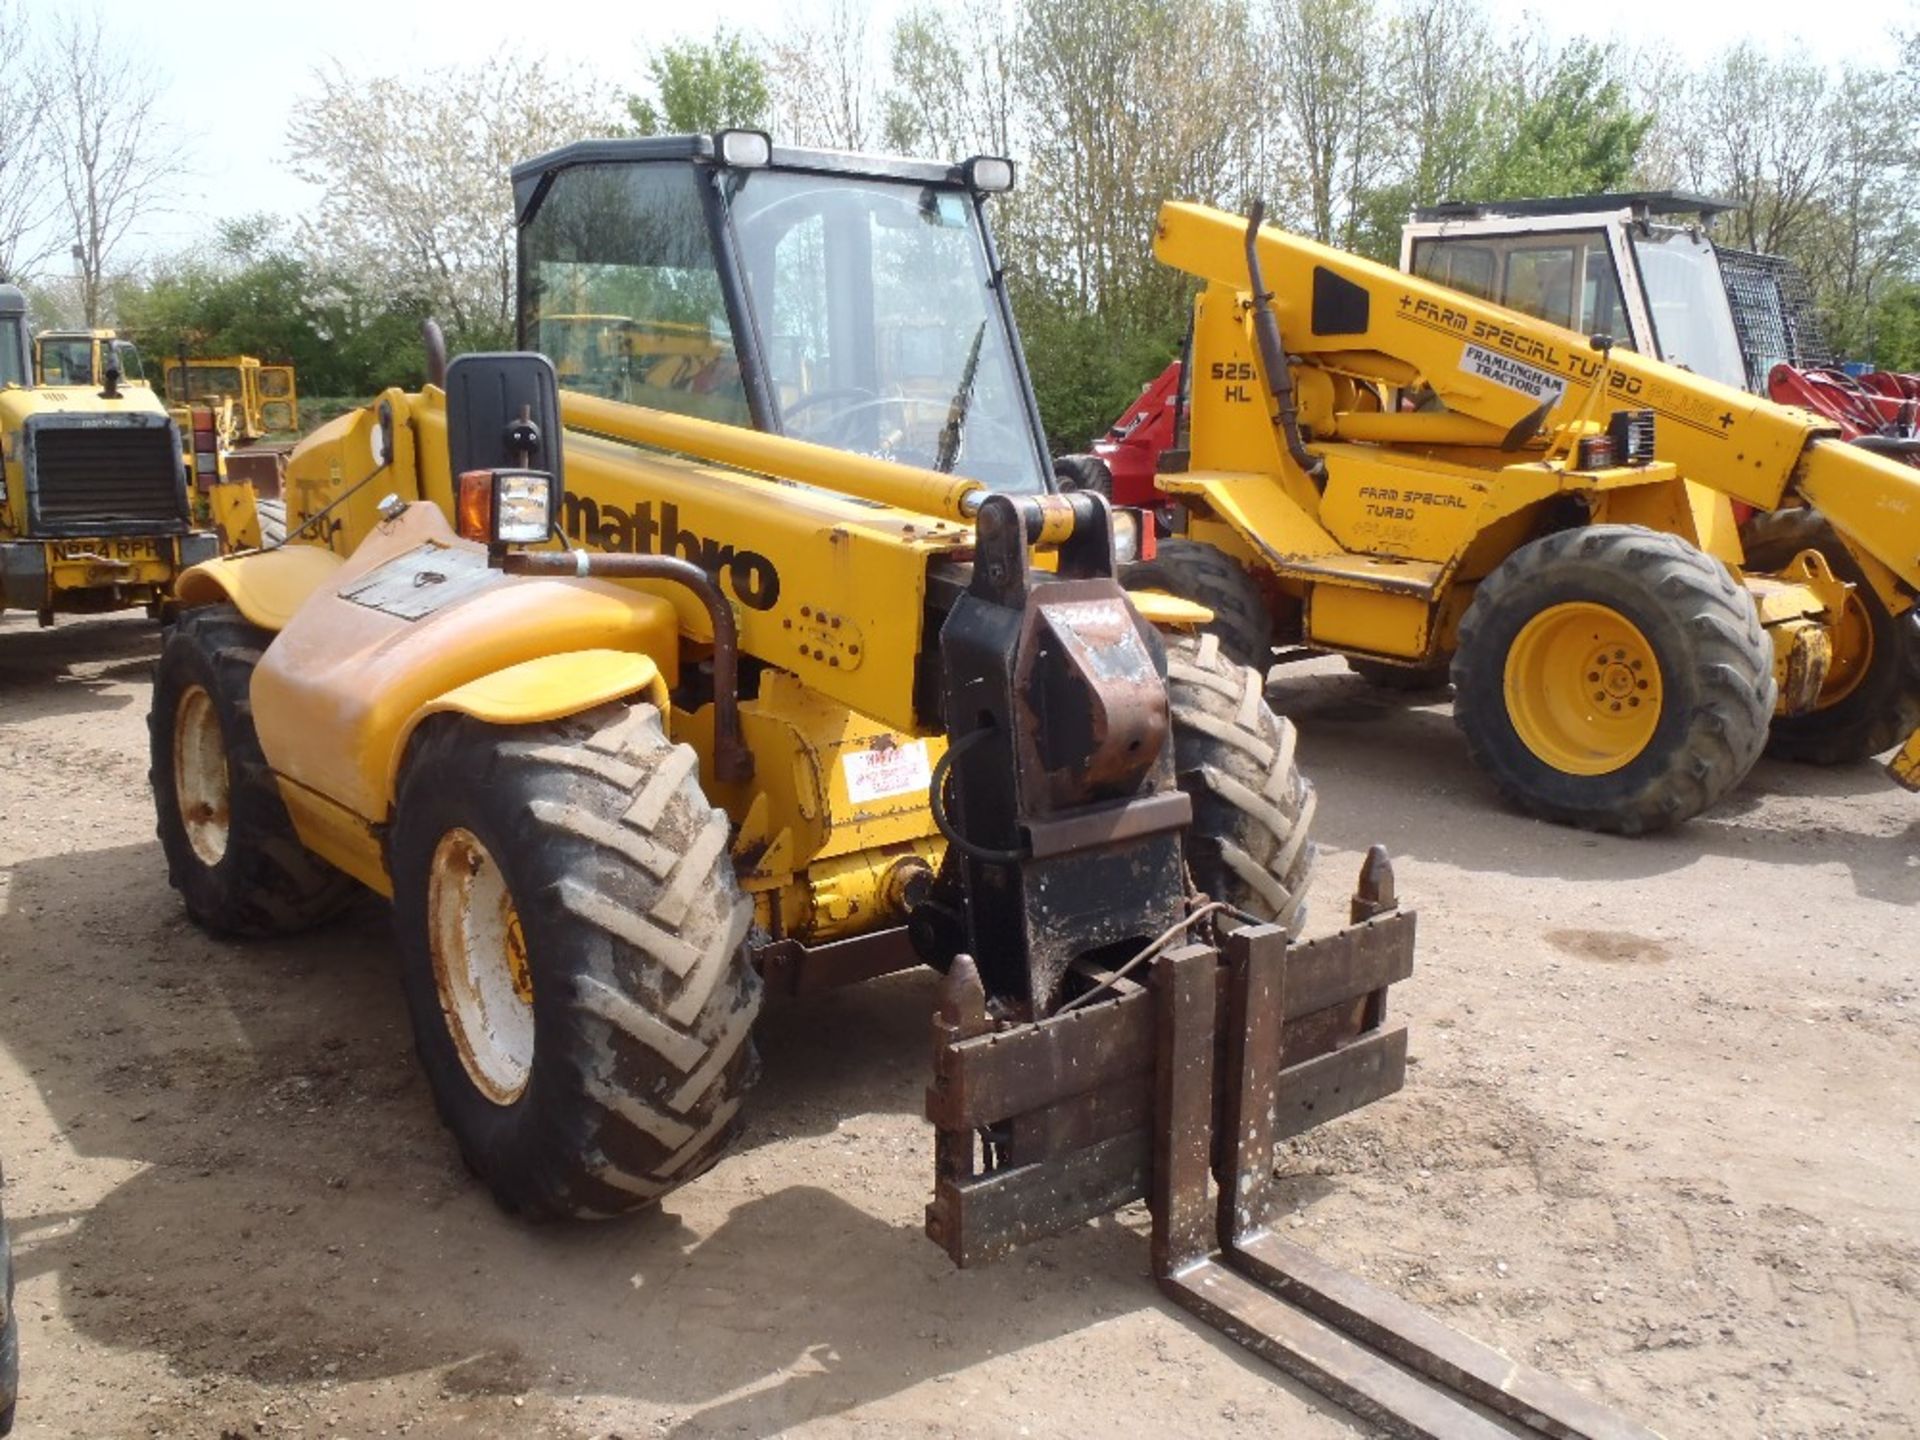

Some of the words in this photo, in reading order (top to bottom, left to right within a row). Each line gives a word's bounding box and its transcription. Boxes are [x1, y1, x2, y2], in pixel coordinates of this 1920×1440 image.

[1414, 299, 1468, 331] FARM
[1472, 319, 1559, 365] SPECIAL
[1466, 347, 1563, 391] FRAMLINGHAM
[1475, 362, 1541, 396] TRACTORS
[1225, 385, 1252, 402] HL
[1359, 487, 1398, 500] FARM
[1403, 490, 1467, 508] SPECIAL
[1366, 504, 1416, 520] TURBO
[117, 540, 158, 558] RPH
